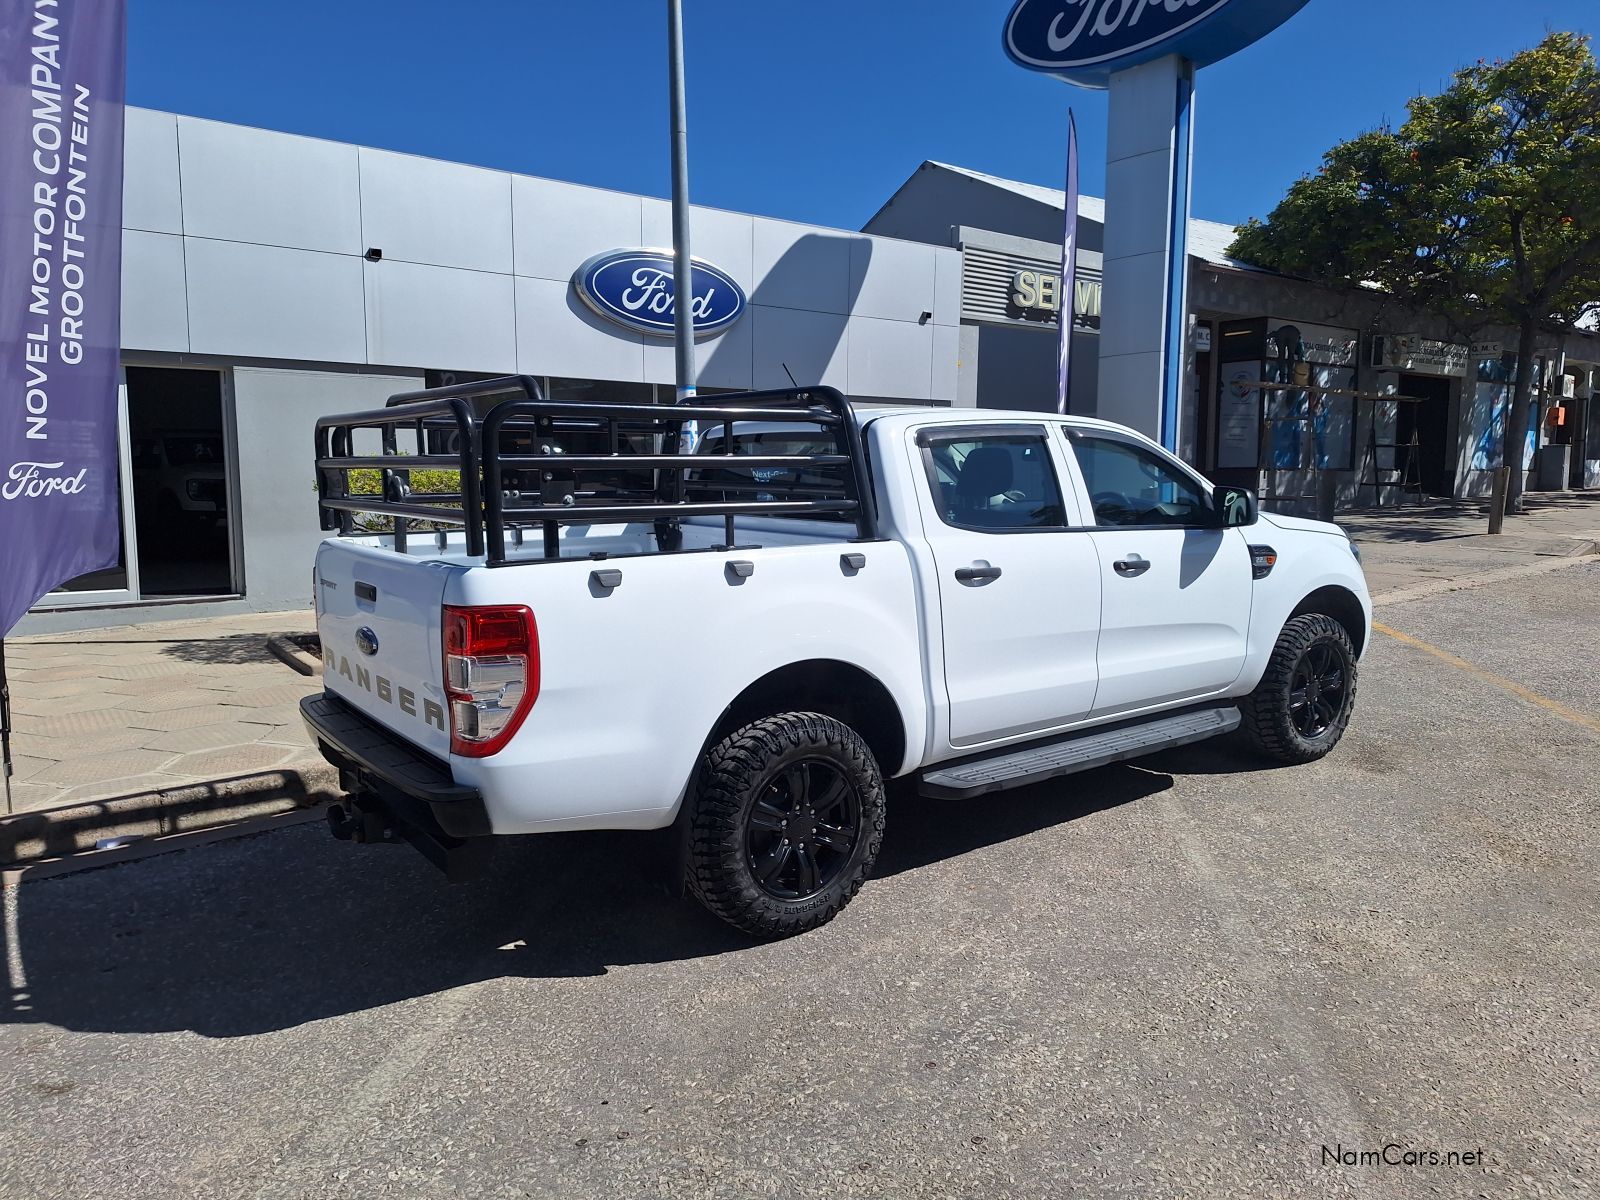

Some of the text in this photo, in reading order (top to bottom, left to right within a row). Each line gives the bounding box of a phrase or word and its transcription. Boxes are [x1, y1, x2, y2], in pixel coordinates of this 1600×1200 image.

[29, 182, 58, 315] MOTOR
[60, 83, 90, 365] GROOTFONTEIN
[1016, 270, 1102, 316] SEVI
[26, 323, 49, 440] NOVEL
[1, 461, 88, 500] Ford
[752, 470, 789, 479] Next-G
[324, 645, 446, 732] RANGER
